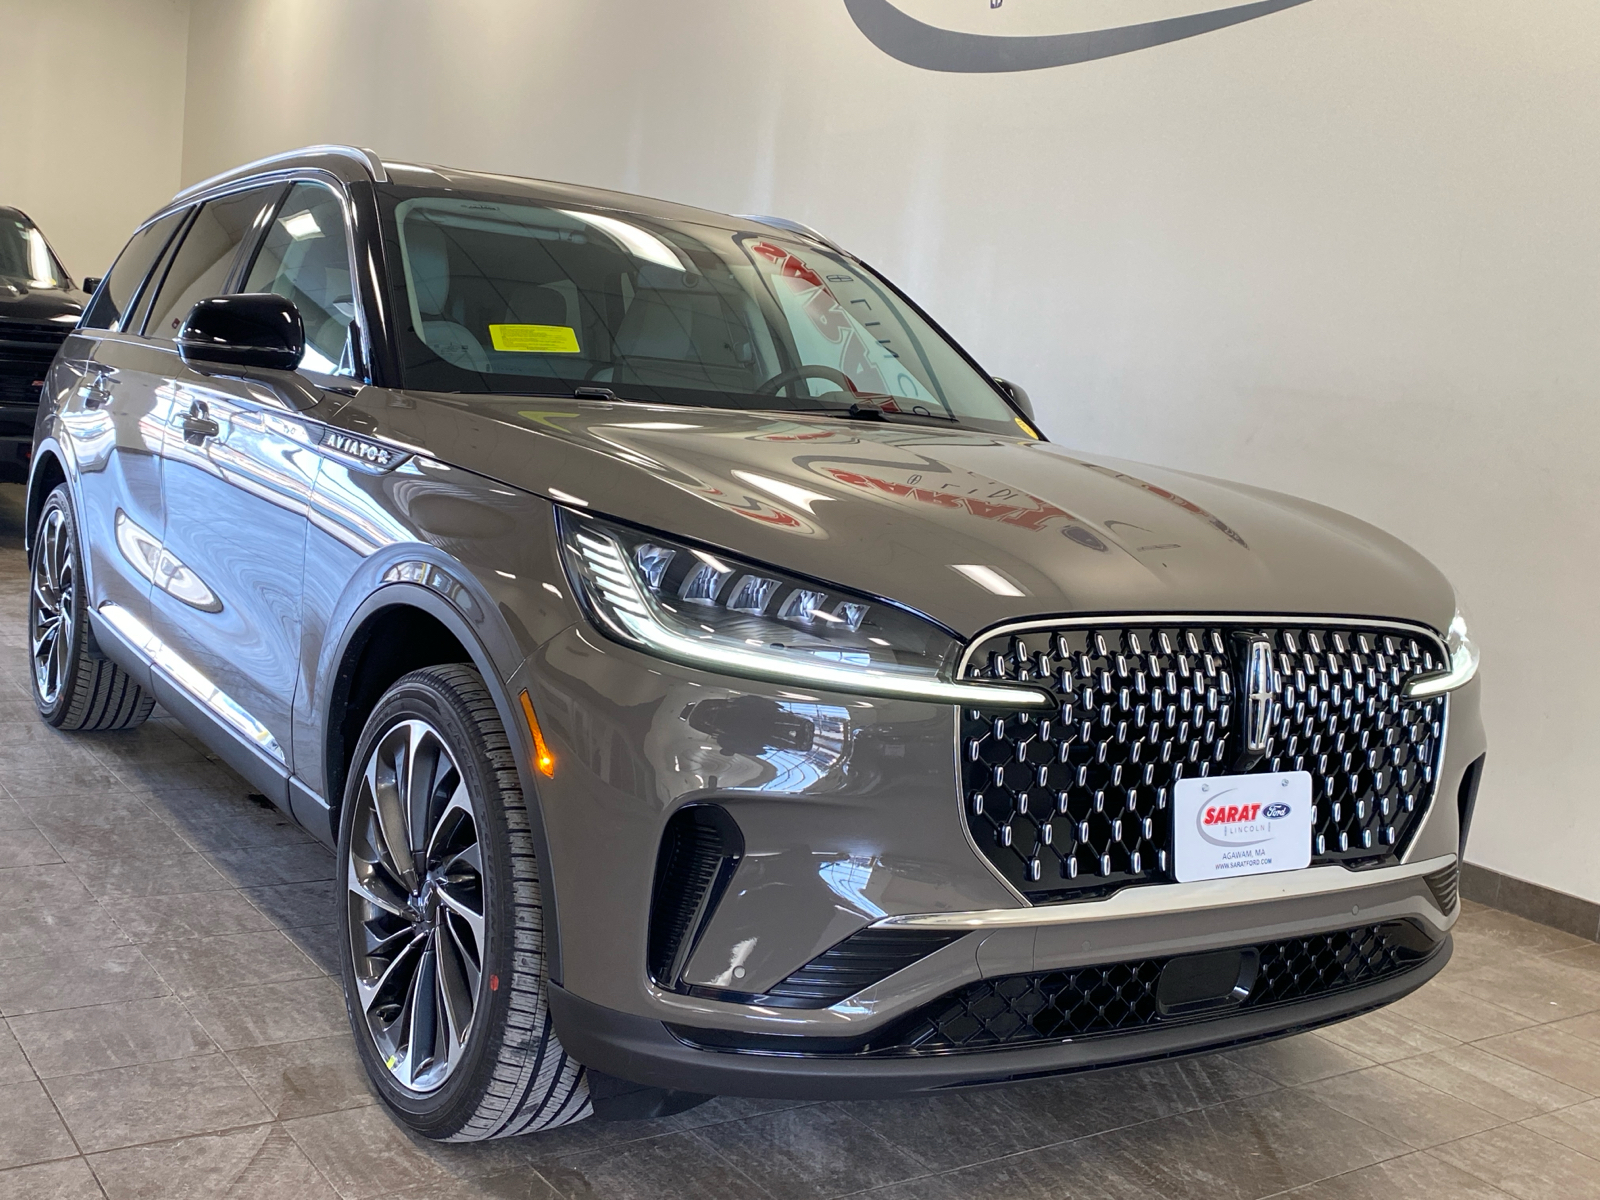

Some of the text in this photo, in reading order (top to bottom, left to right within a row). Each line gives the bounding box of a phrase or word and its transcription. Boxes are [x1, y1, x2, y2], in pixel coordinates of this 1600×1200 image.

[327, 434, 391, 465] AVIATOR
[1203, 803, 1287, 825] SARAT Ford
[1229, 825, 1266, 834] LINCOLN
[1222, 848, 1266, 860] AGAWAM, MA
[1215, 857, 1272, 870] WWW.SARATFORD.COM
